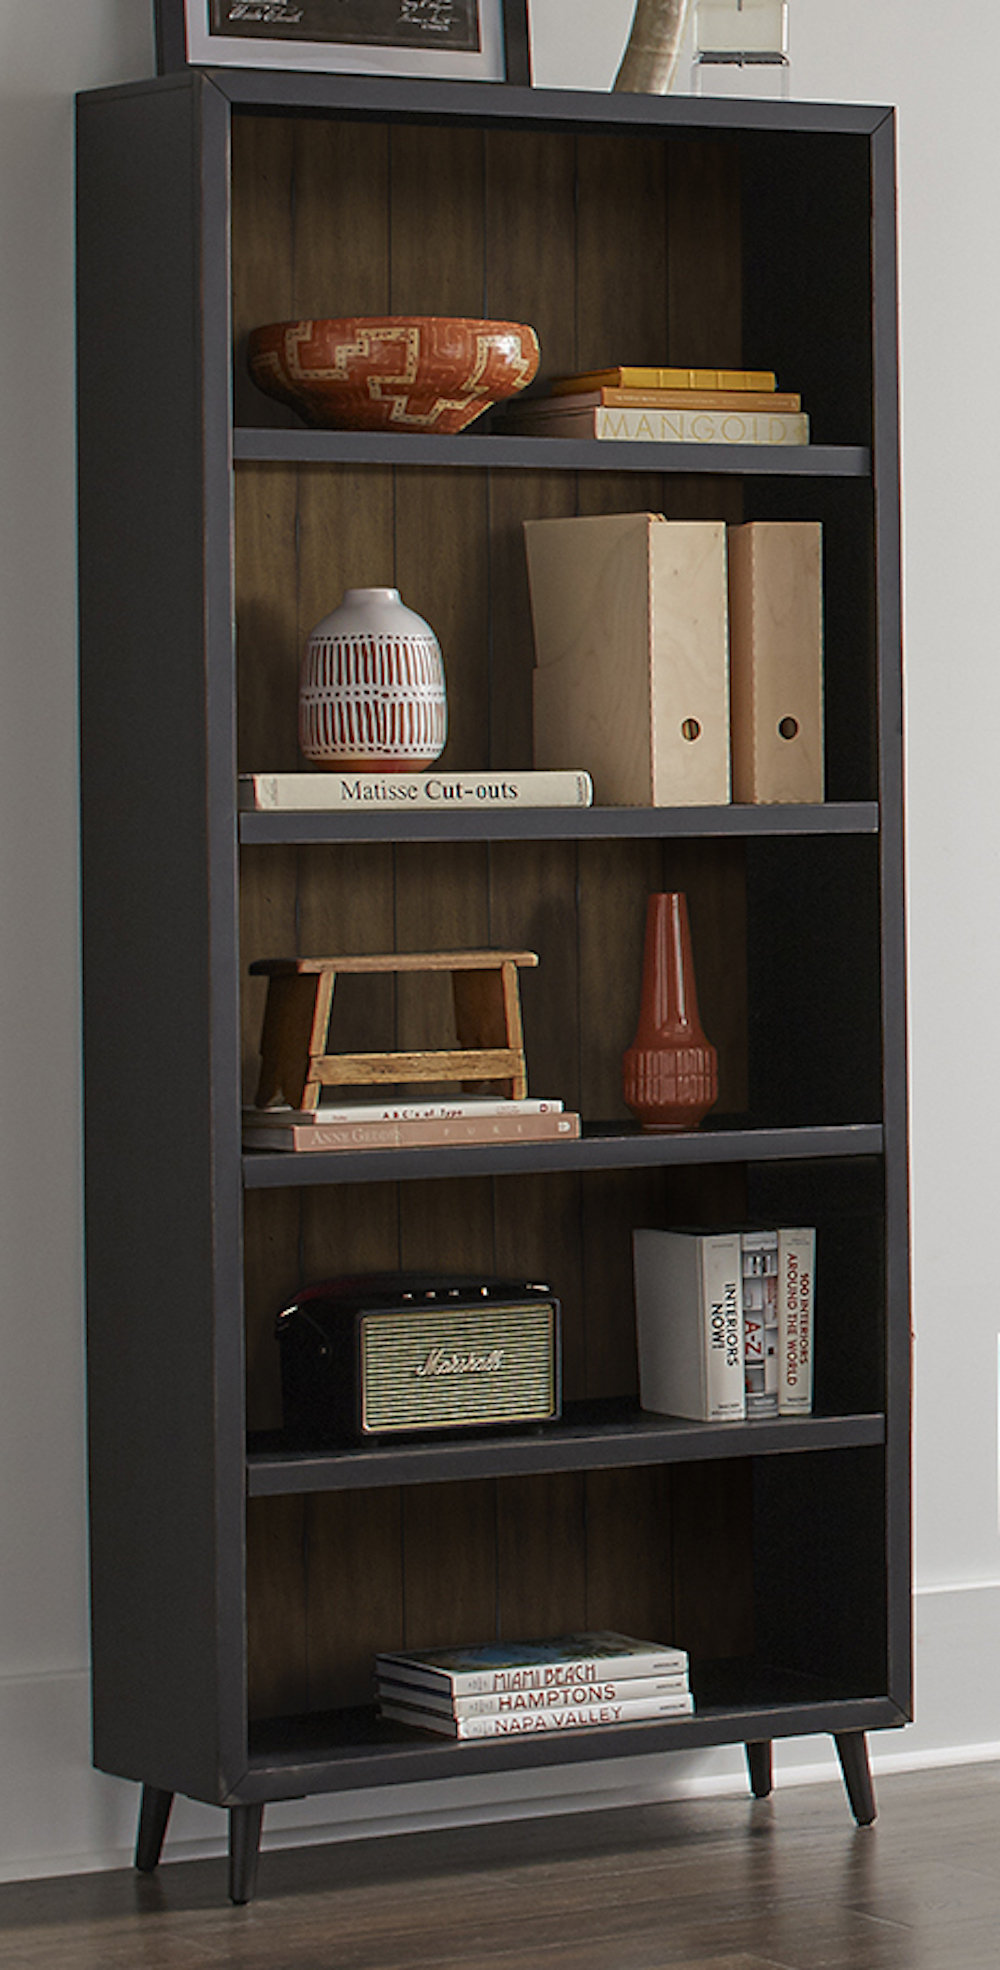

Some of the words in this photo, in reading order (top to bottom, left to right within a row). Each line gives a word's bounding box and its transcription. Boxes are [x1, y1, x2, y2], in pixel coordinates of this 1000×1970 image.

[340, 779, 417, 800] Matisse
[424, 779, 519, 801] Cut-outs
[786, 1253, 798, 1310] AROUND
[711, 1303, 725, 1350] NOW!
[724, 1283, 740, 1367] INTERIORS
[744, 1320, 762, 1355] A-Z
[786, 1316, 798, 1335] THE
[799, 1299, 810, 1365] INTERIORS
[415, 1348, 504, 1376] Marshall
[786, 1340, 798, 1386] WORLD
[493, 1670, 541, 1690] MIAMI
[544, 1664, 597, 1684] BEACH
[498, 1684, 616, 1711] HAMPTONS
[495, 1715, 547, 1733] NAPA
[553, 1706, 622, 1725] VALLEY
